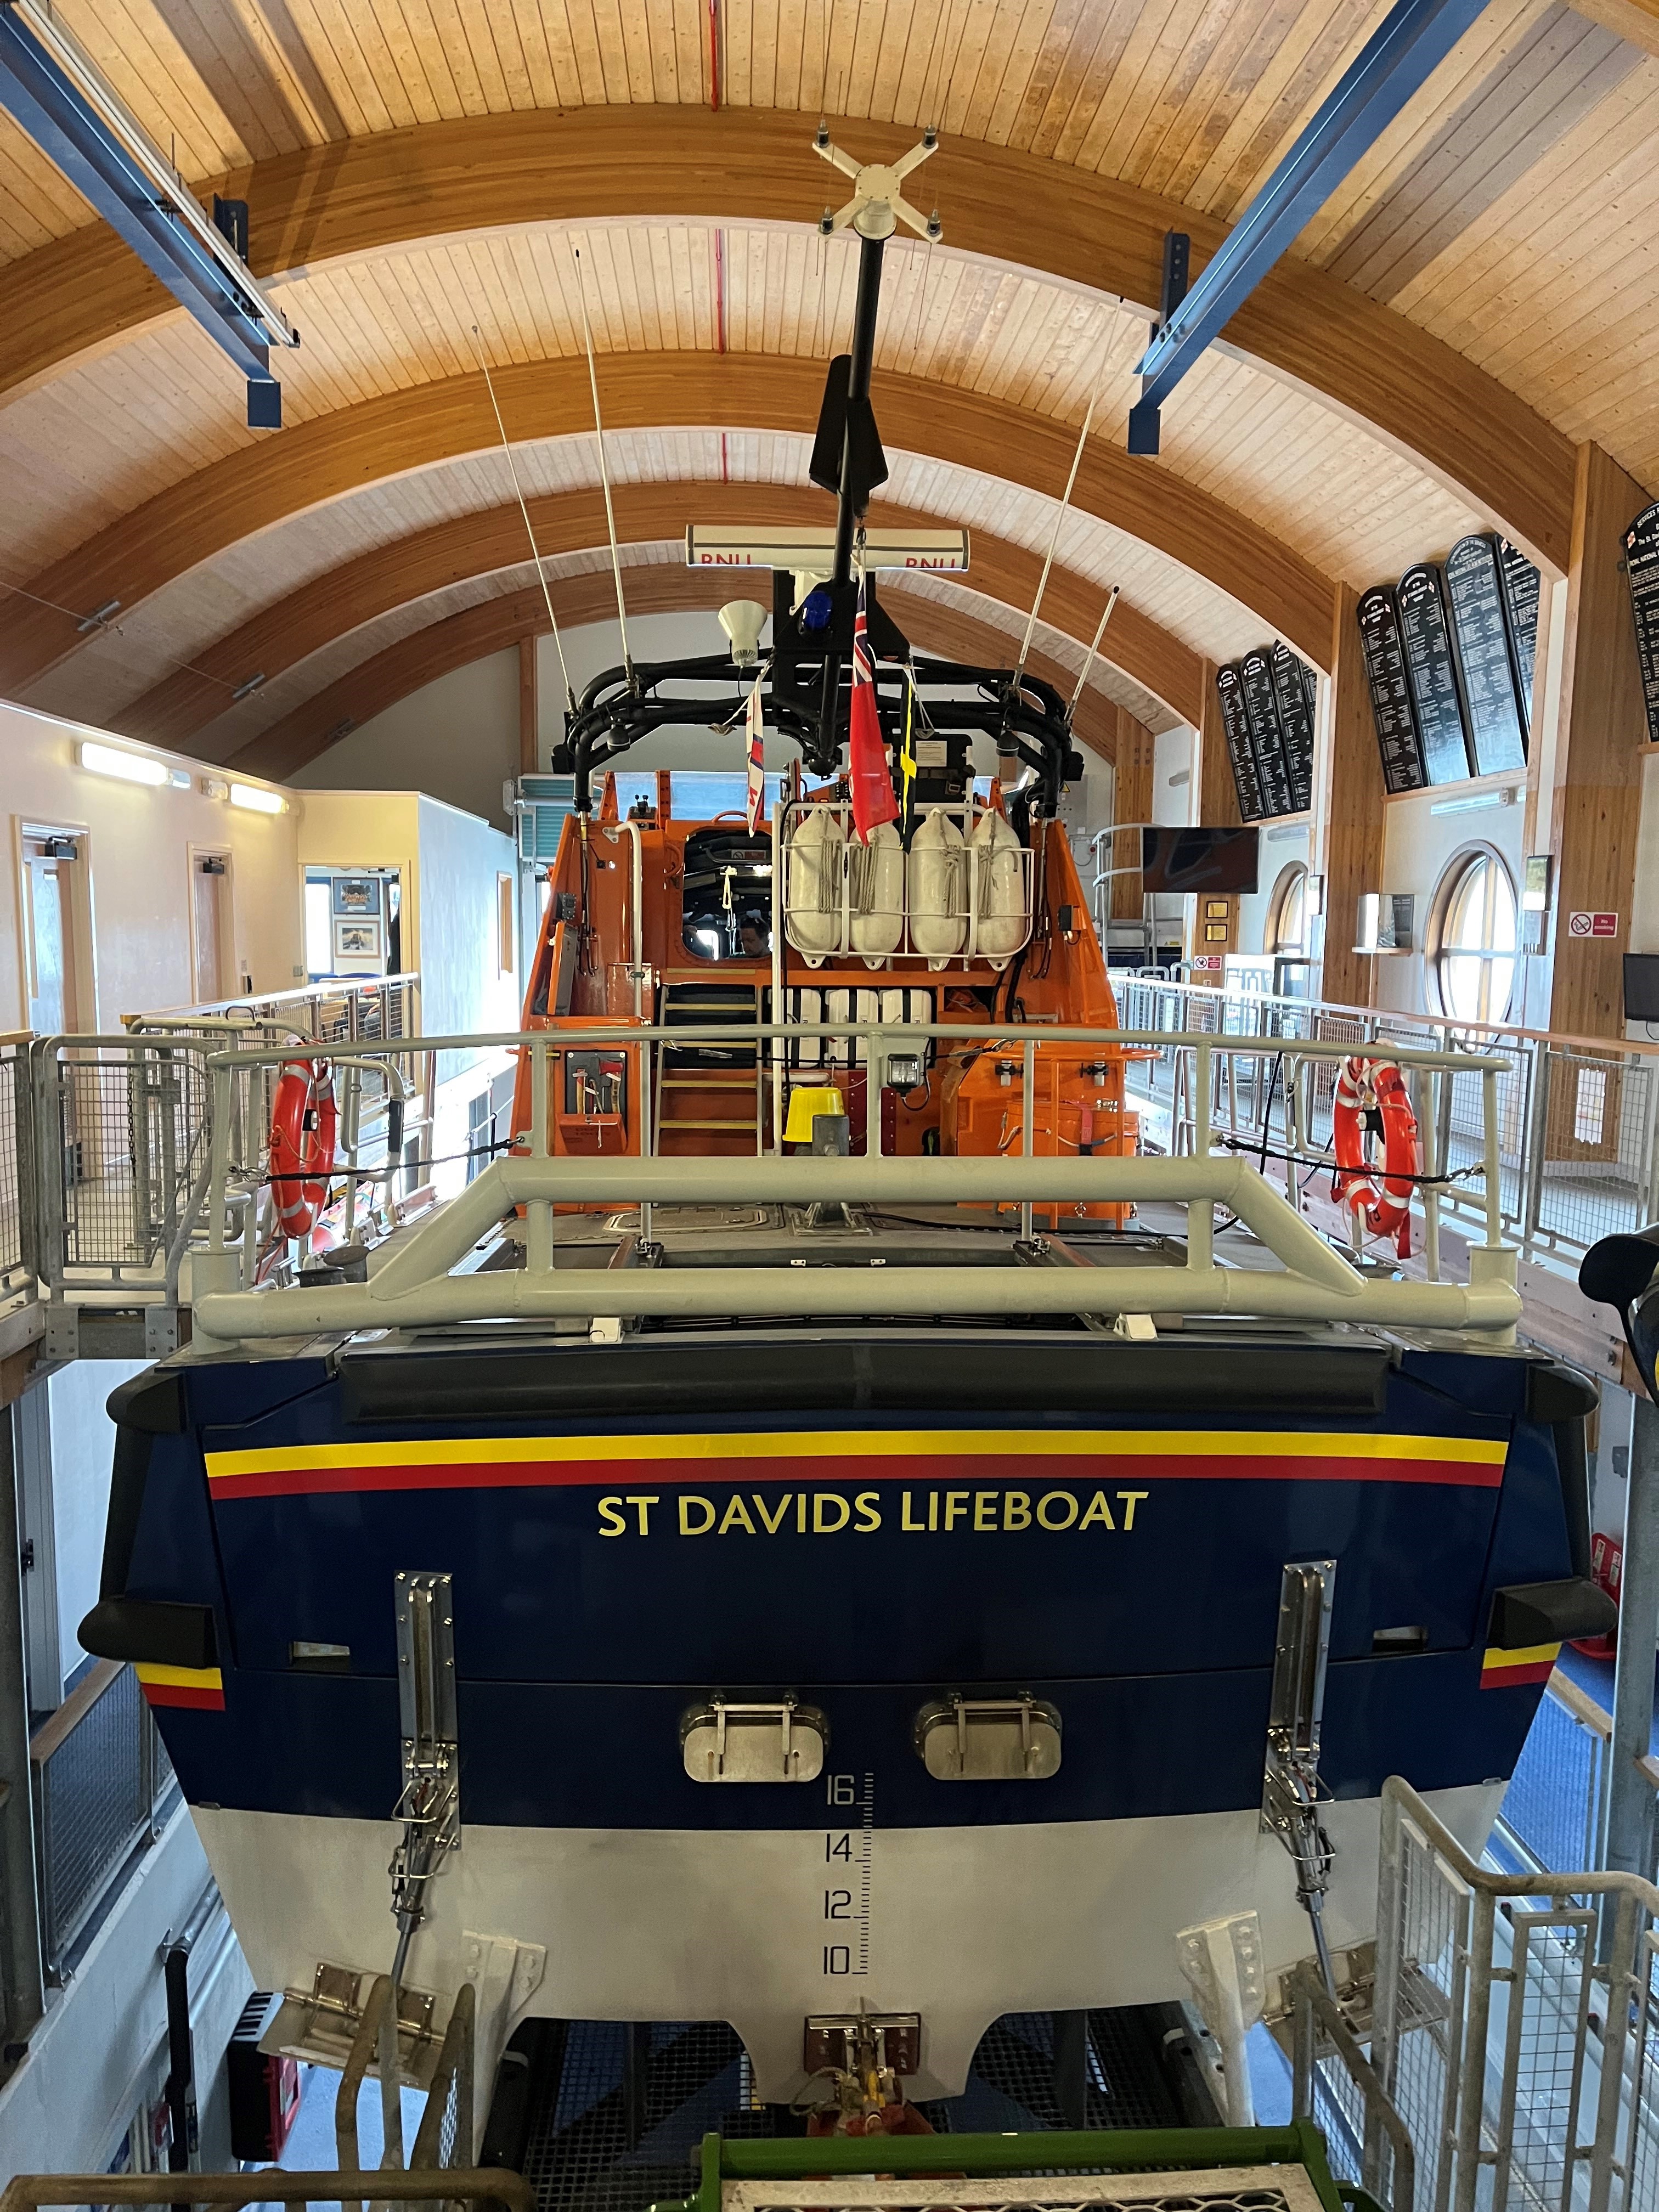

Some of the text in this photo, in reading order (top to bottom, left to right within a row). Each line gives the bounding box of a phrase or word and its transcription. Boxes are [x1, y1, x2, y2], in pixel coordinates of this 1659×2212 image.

[598, 1491, 1149, 1536] ST DAVIDS LIFEBOAT
[827, 1775, 855, 1805] 16
[826, 1833, 853, 1863] 14
[825, 1890, 851, 1919] 12
[823, 1946, 850, 1974] 10
